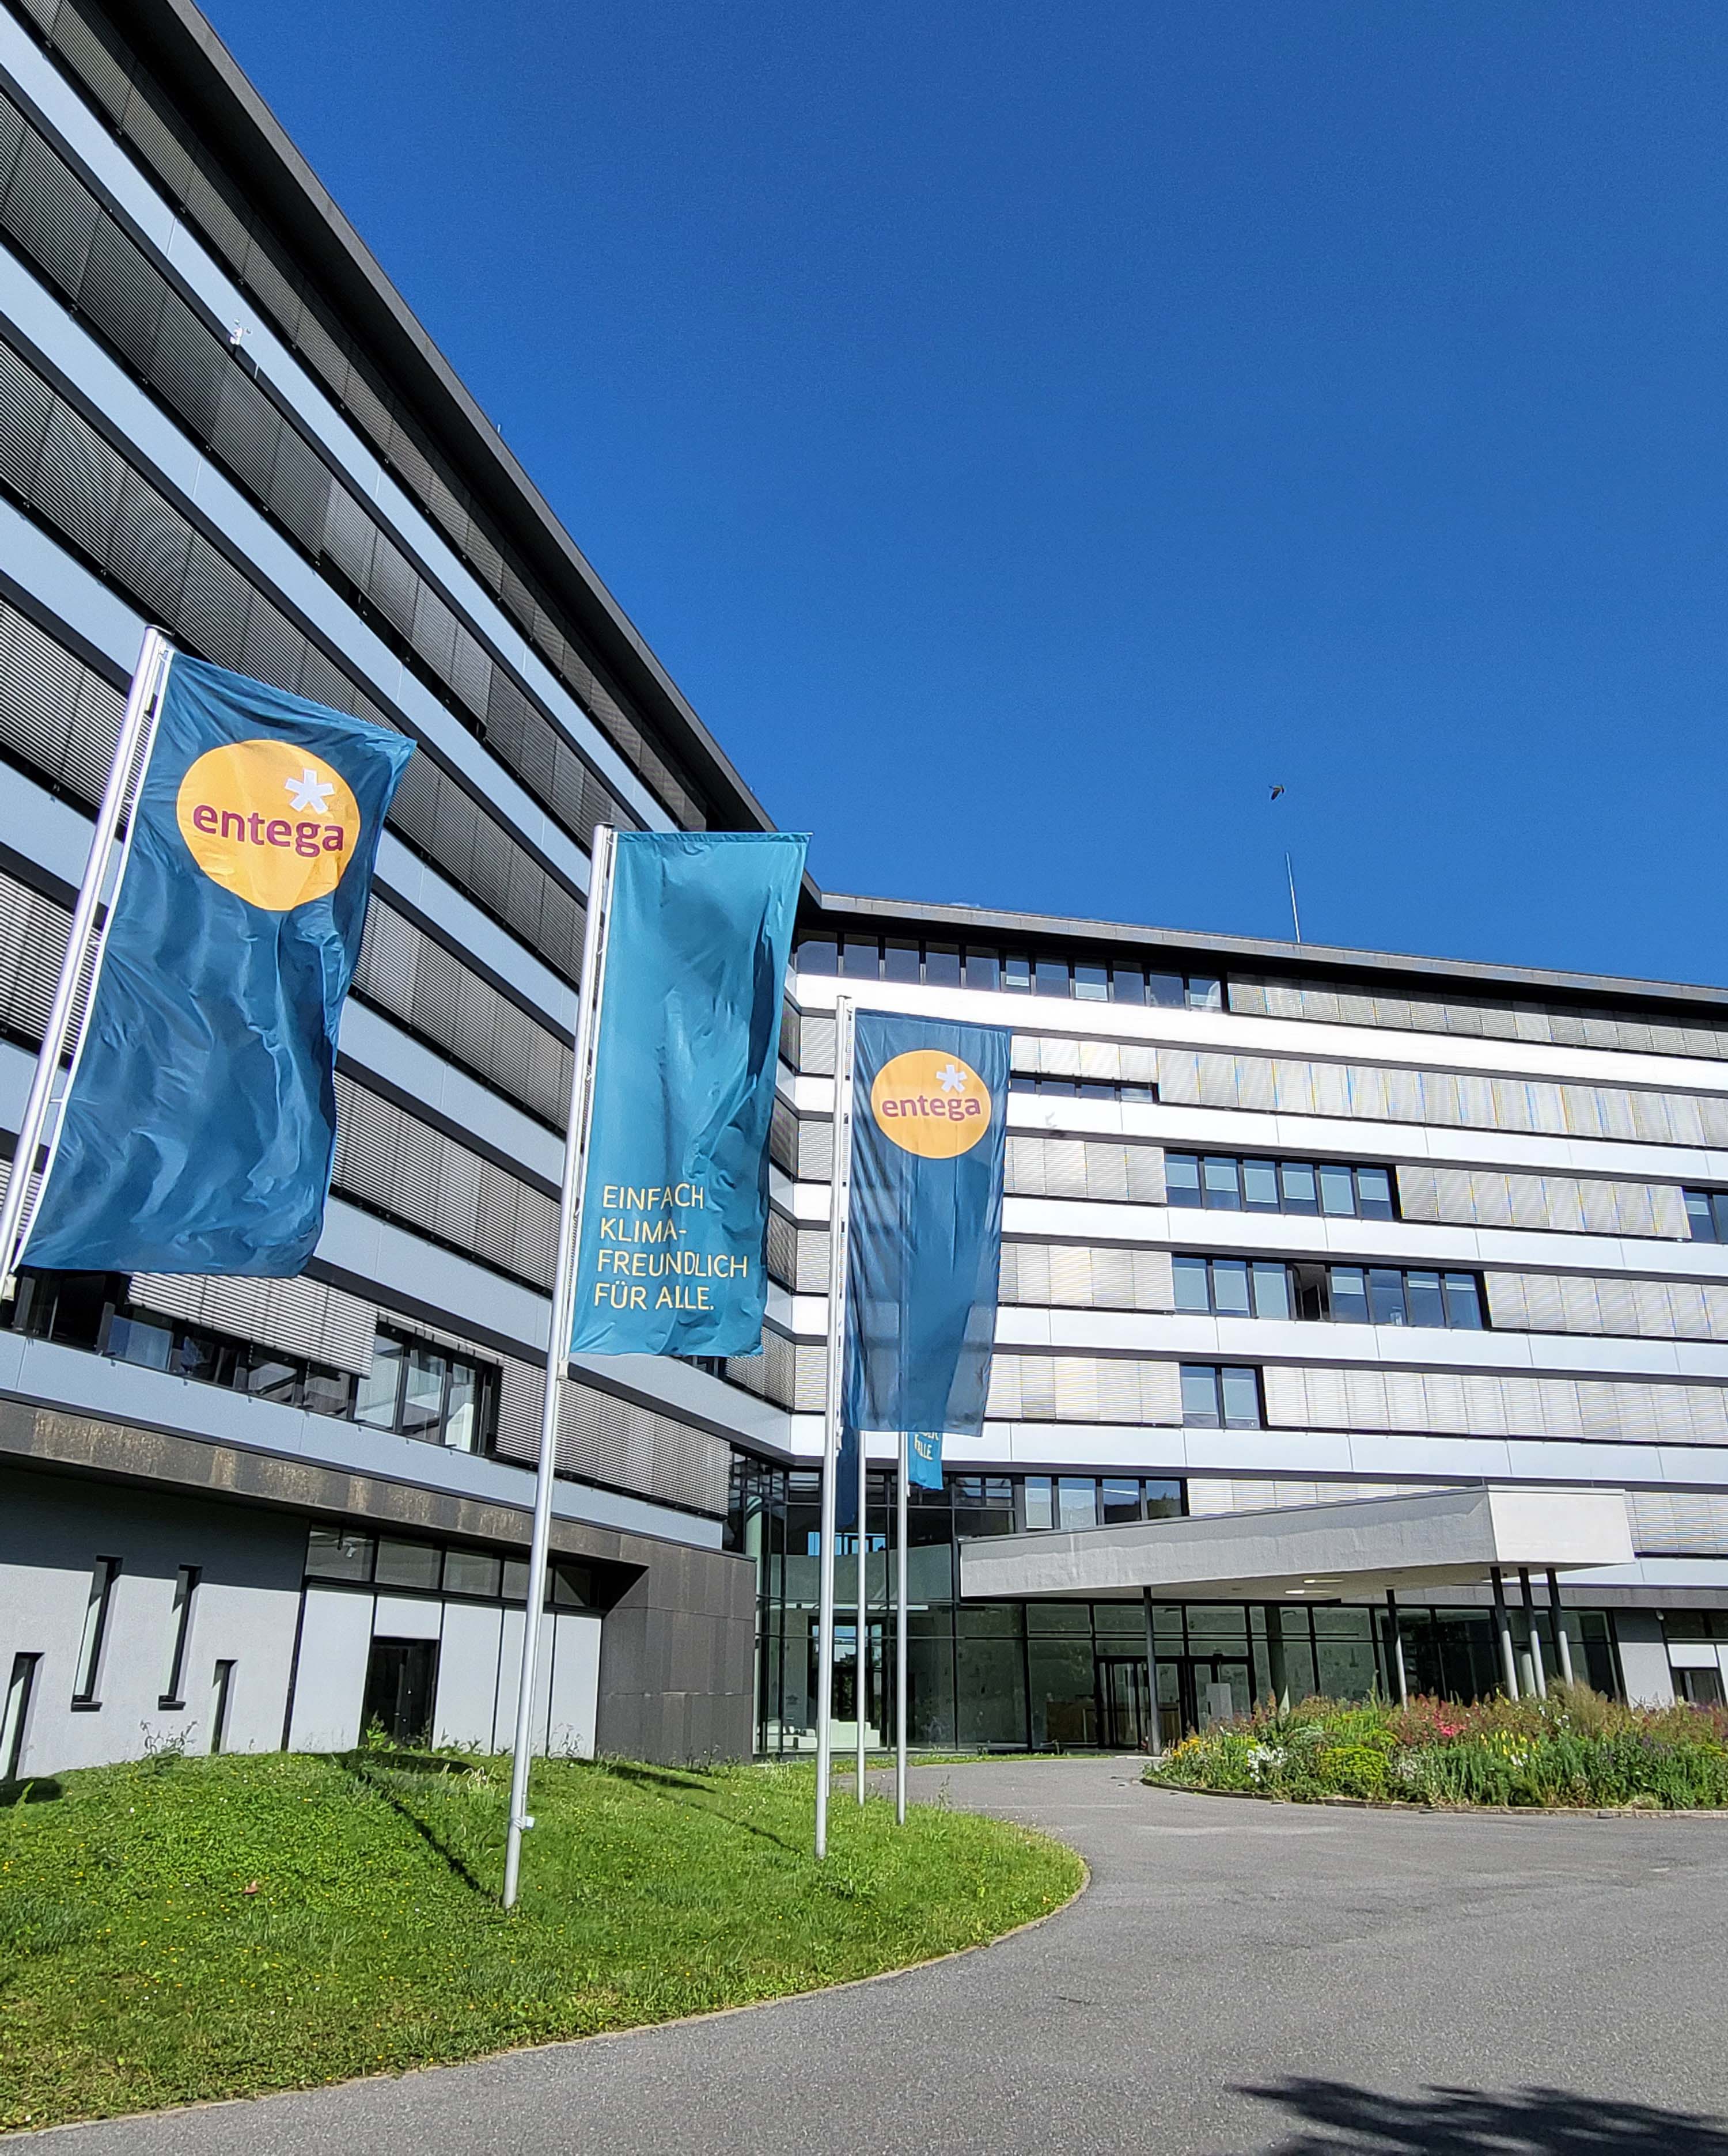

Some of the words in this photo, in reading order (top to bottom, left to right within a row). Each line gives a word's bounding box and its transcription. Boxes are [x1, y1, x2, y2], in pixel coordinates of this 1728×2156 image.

[193, 804, 344, 857] entega
[882, 1095, 981, 1121] entega
[602, 1183, 703, 1210] EINFACH
[600, 1217, 687, 1244] KLIMA-
[597, 1249, 748, 1278] FREUNDLICH
[594, 1280, 647, 1311] FÜR
[655, 1285, 715, 1311] ALLE.
